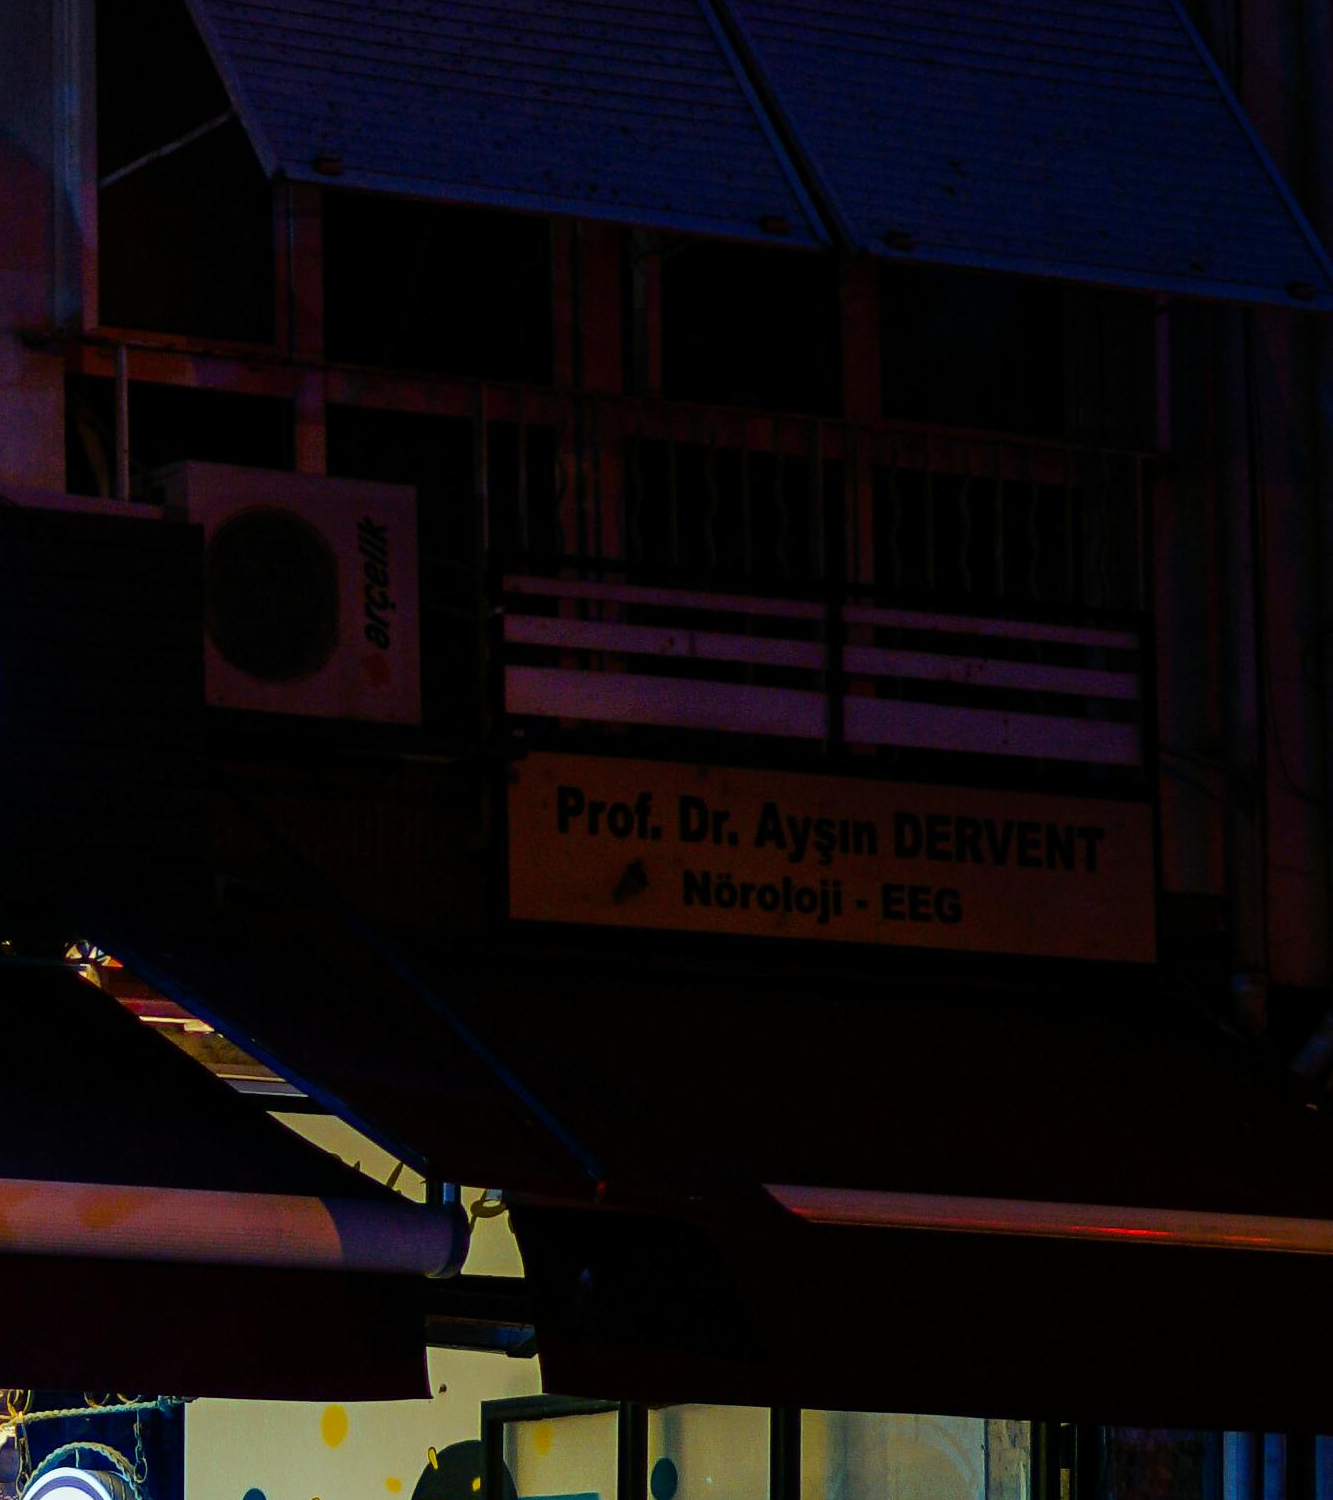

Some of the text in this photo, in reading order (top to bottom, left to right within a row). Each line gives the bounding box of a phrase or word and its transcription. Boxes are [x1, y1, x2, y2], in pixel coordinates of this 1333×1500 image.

[357, 515, 396, 650] arçelik
[555, 785, 662, 840] Prof.
[679, 795, 739, 846] Dr.
[893, 811, 1106, 873] DERVENT
[681, 869, 843, 925] Nöroloji
[881, 883, 964, 925] EEG
